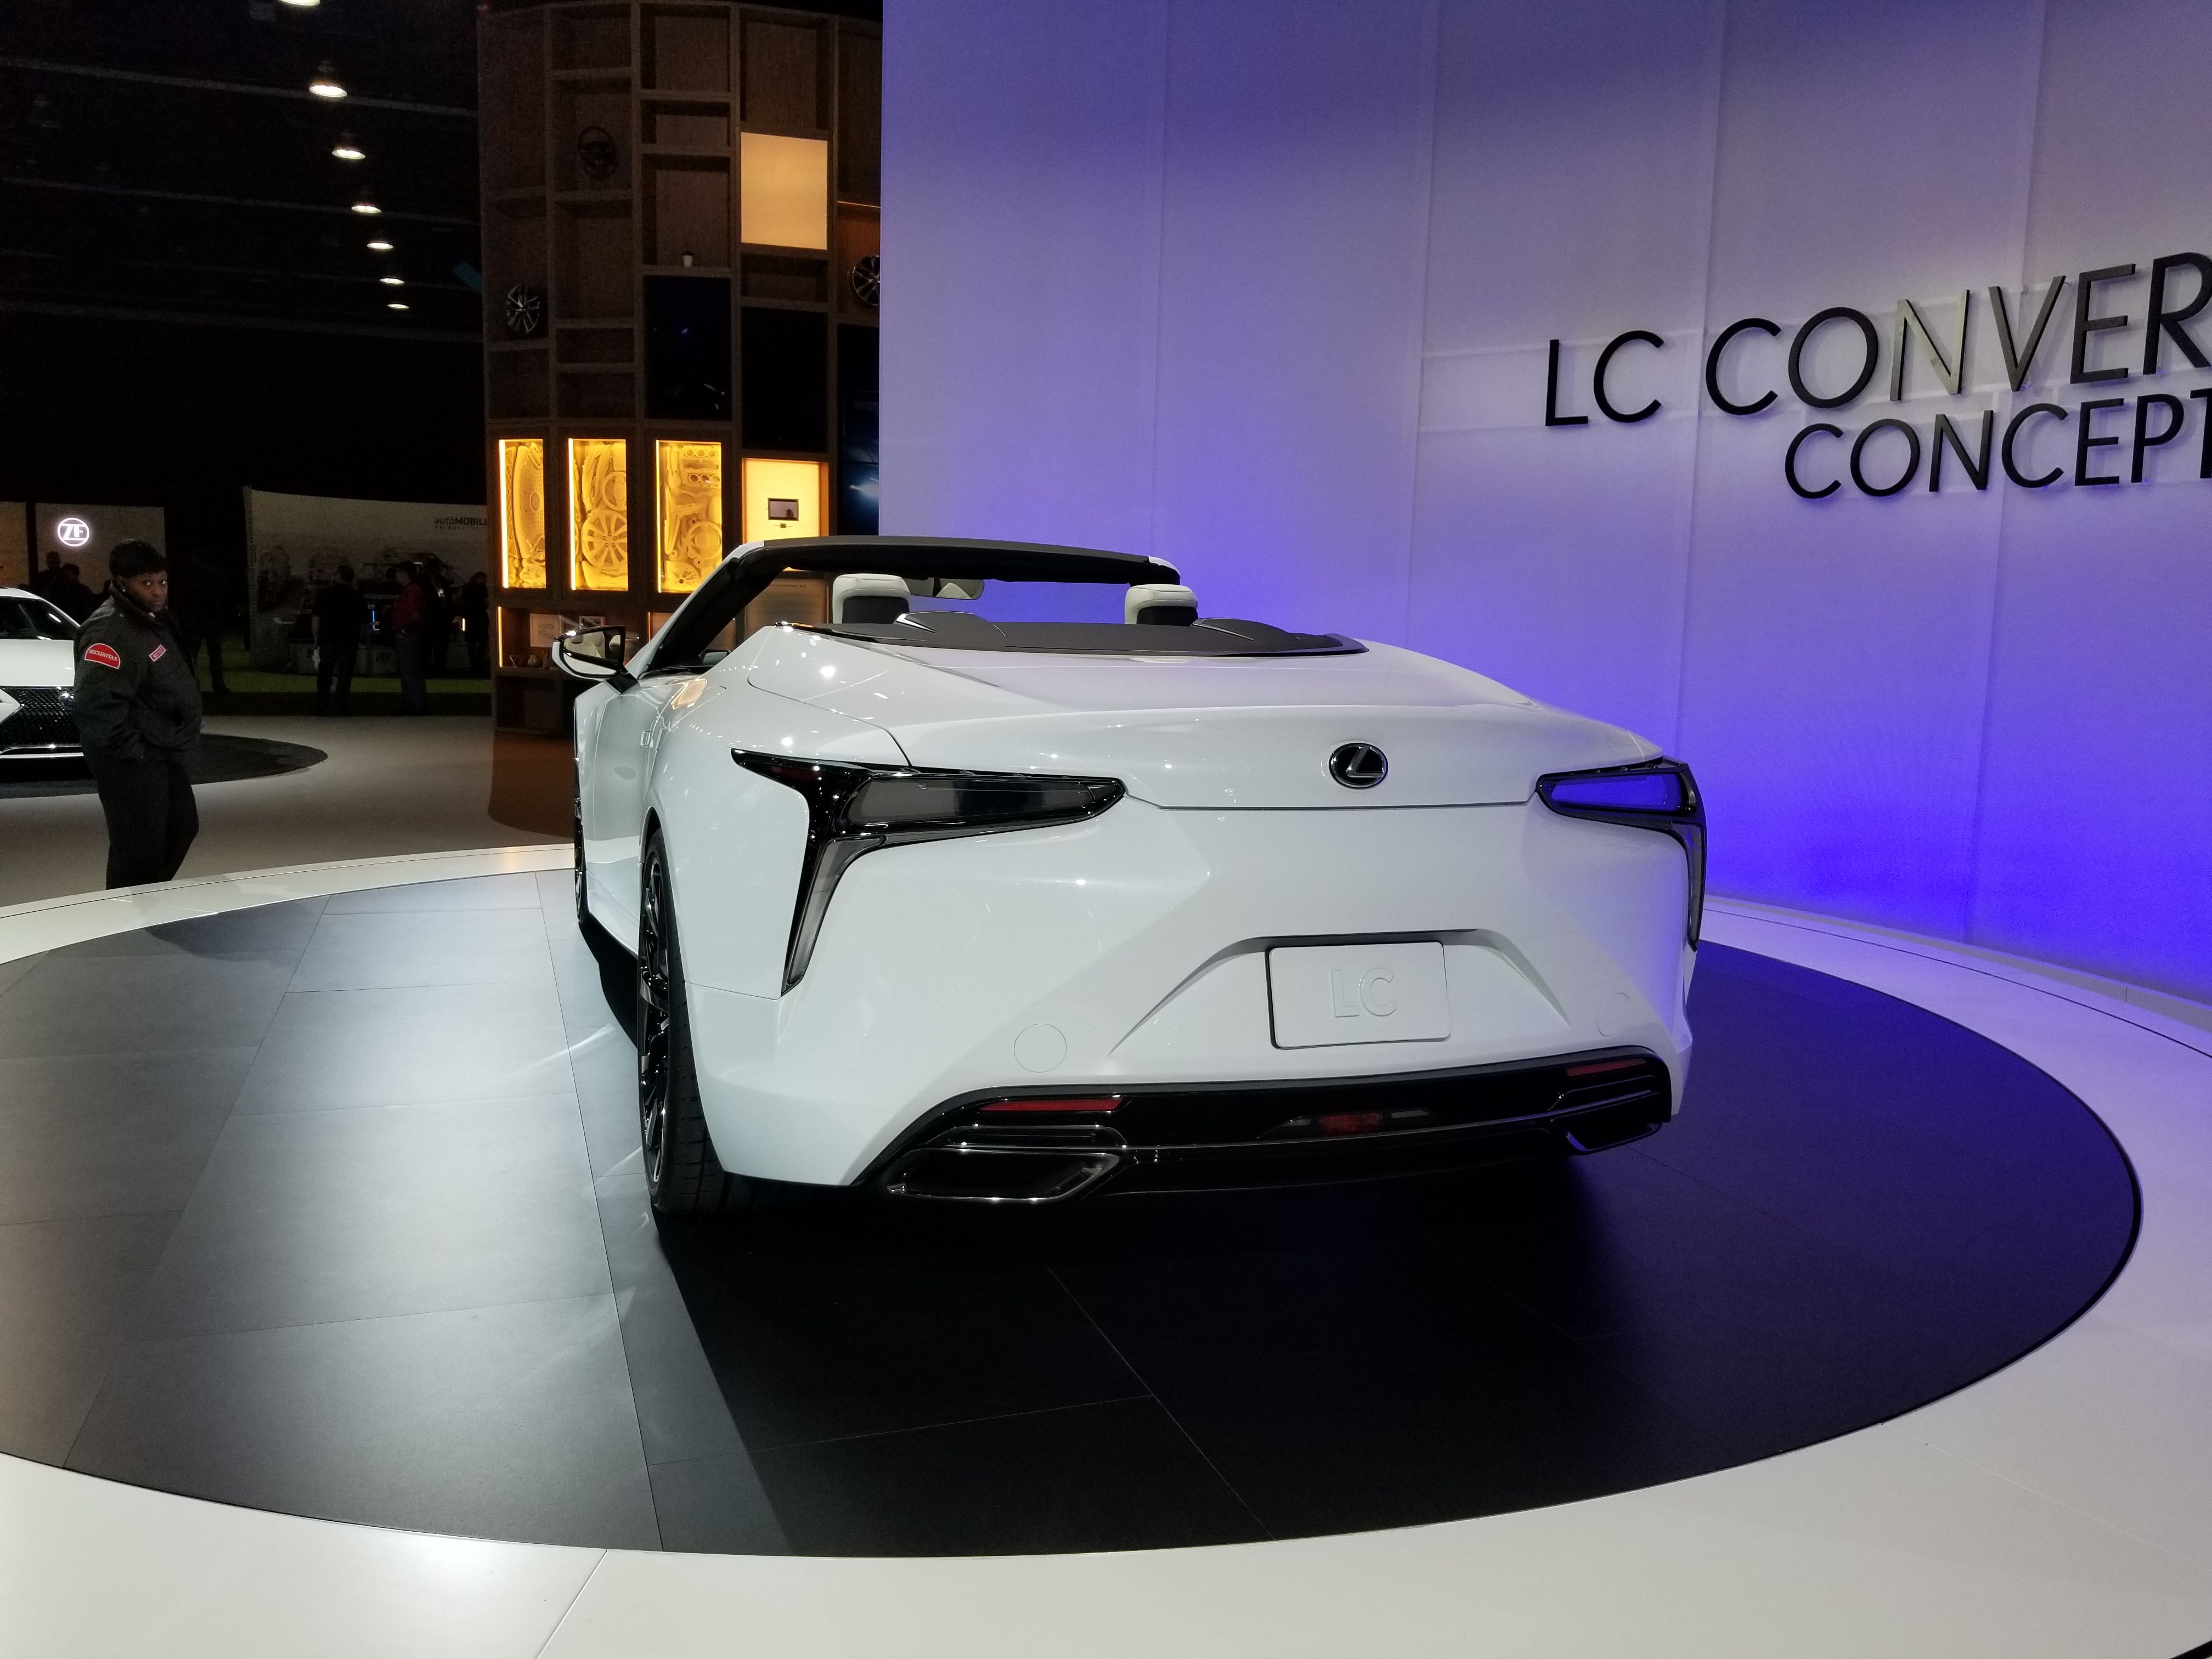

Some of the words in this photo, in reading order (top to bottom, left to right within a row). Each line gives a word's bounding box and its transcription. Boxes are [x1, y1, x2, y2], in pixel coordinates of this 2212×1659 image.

[1545, 330, 1664, 426] LC
[1705, 252, 2212, 415] CONVER
[1785, 388, 2212, 499] CONCEPT
[58, 523, 88, 541] ZF
[88, 649, 118, 662] SECURITAS
[1330, 967, 1397, 1018] LC
